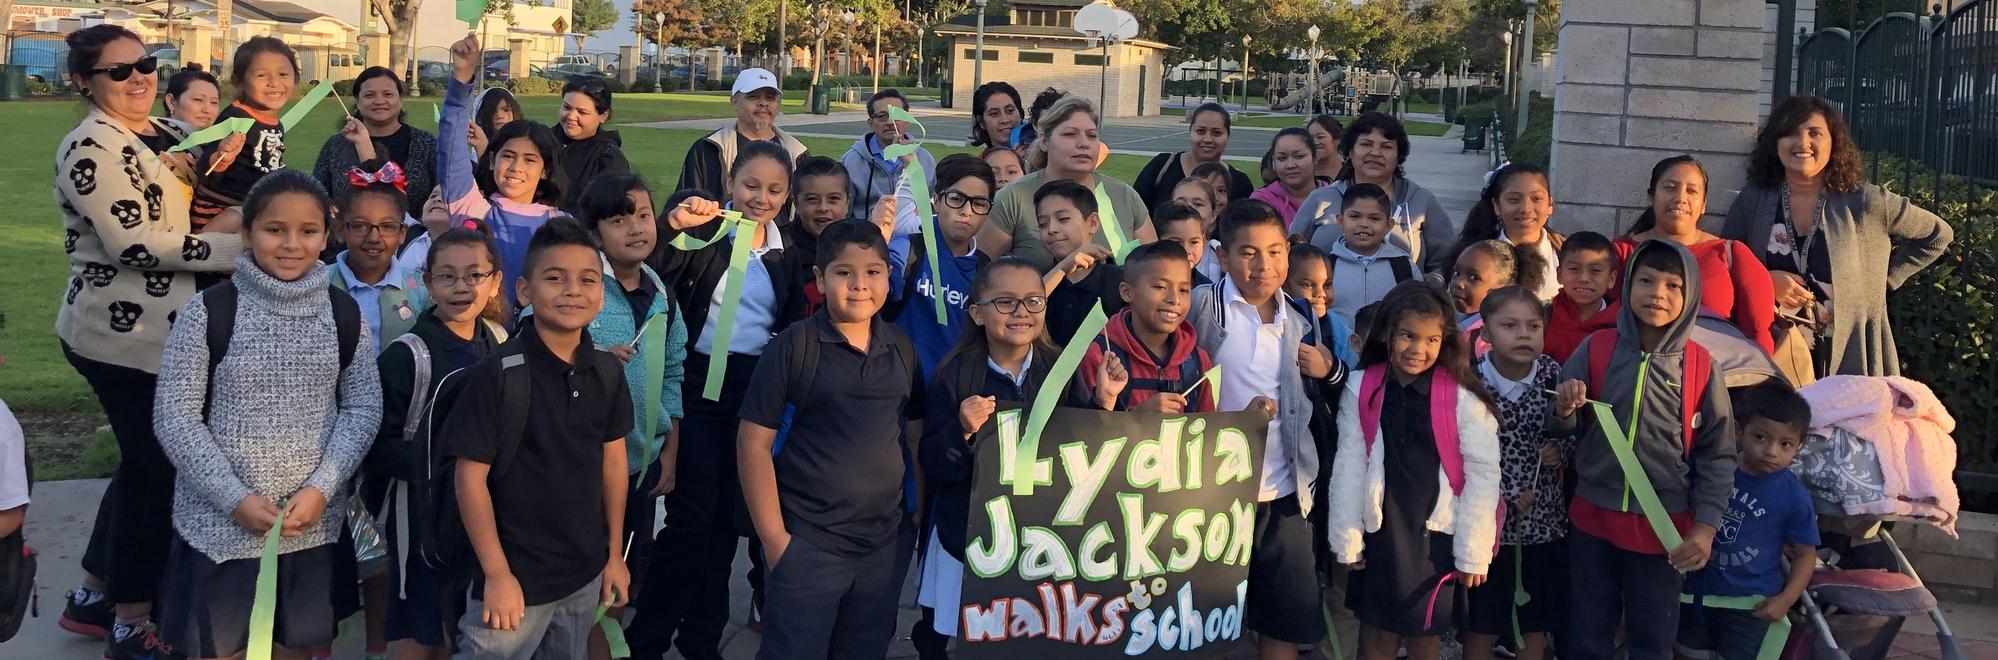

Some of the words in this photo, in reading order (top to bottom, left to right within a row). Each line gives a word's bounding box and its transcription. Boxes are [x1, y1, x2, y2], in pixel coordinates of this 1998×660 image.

[52, 8, 72, 17] SHOP
[219, 20, 230, 29] 35
[916, 278, 969, 309] Hurley
[997, 408, 1252, 526] Lydia
[1731, 487, 1766, 517] YALS
[966, 491, 1256, 581] Jackson
[1126, 577, 1168, 610] to
[963, 581, 1129, 645] walks
[1124, 579, 1248, 656] school
